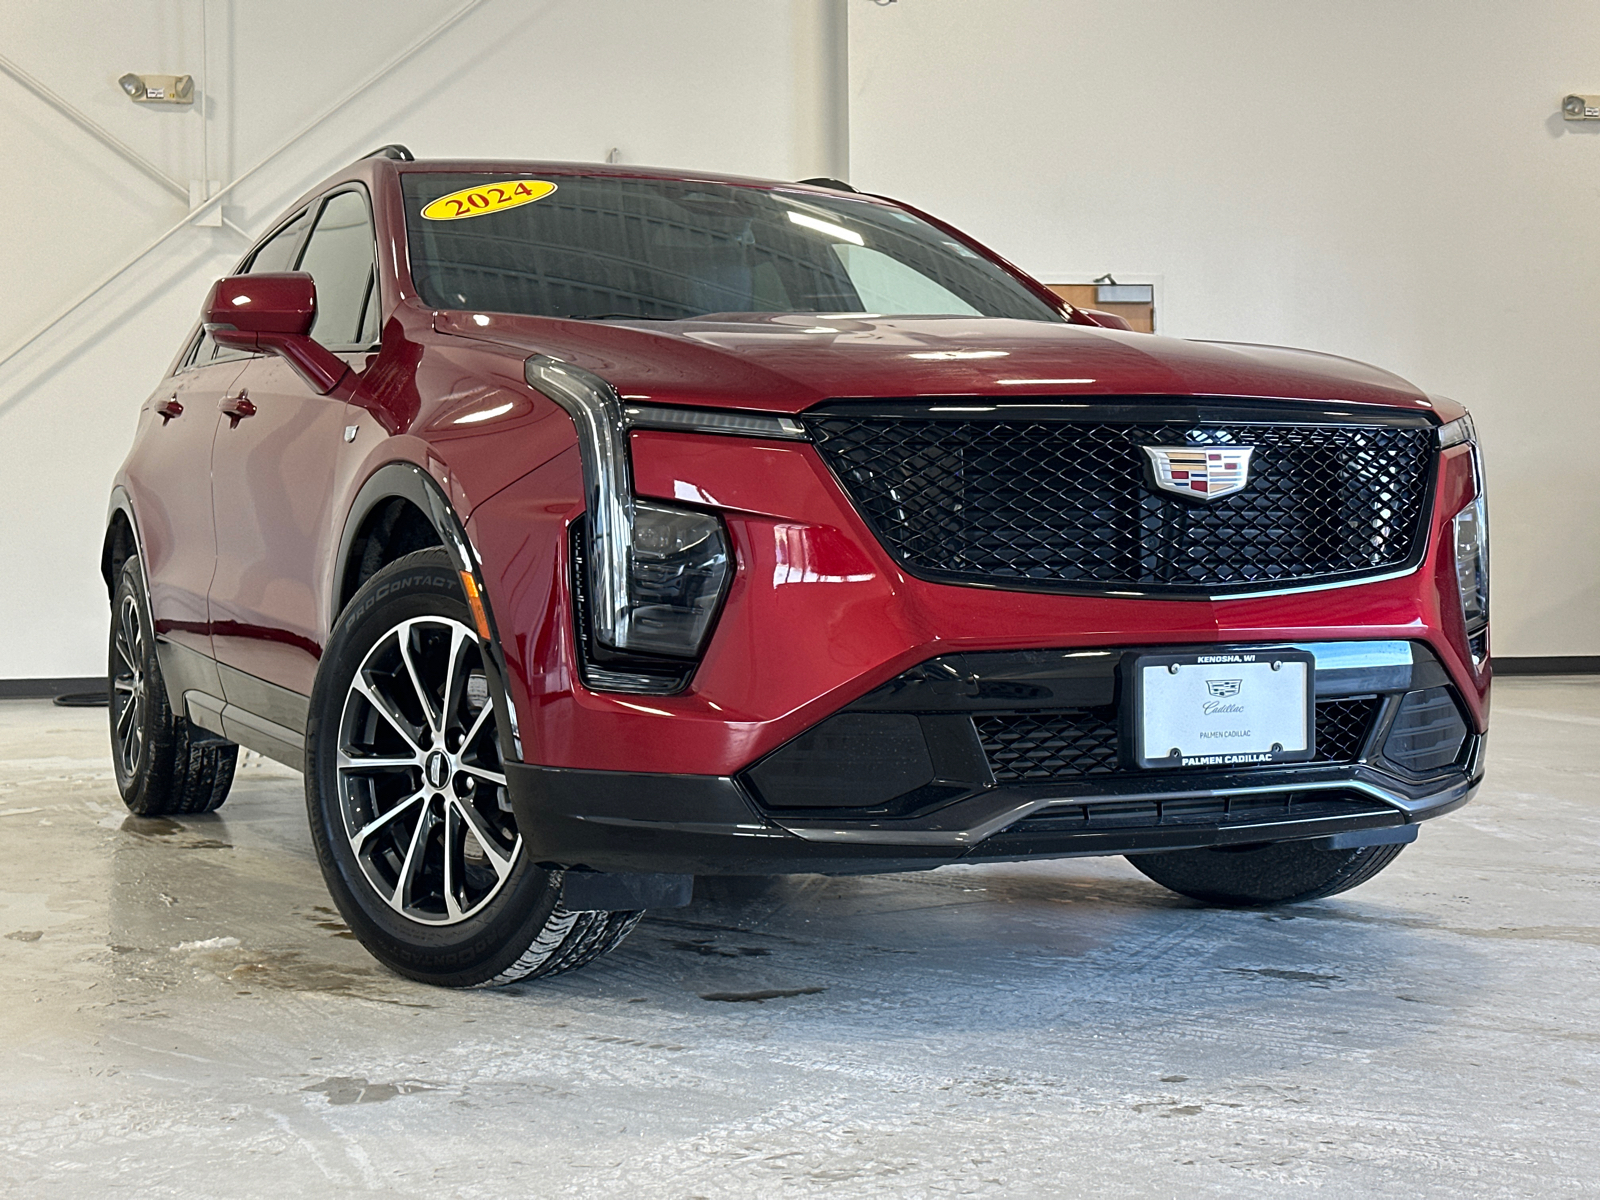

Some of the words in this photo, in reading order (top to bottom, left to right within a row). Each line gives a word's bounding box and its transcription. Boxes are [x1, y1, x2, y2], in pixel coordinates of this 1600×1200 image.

[445, 182, 533, 217] 2024
[1197, 654, 1242, 664] KENOSHA,
[1244, 654, 1255, 662] WI
[1202, 701, 1245, 716] Cadillac
[1200, 731, 1223, 739] PALMEN
[1224, 729, 1251, 737] CADILLAC
[1182, 756, 1223, 766] PALMEN
[1224, 753, 1273, 764] CADILLAC
